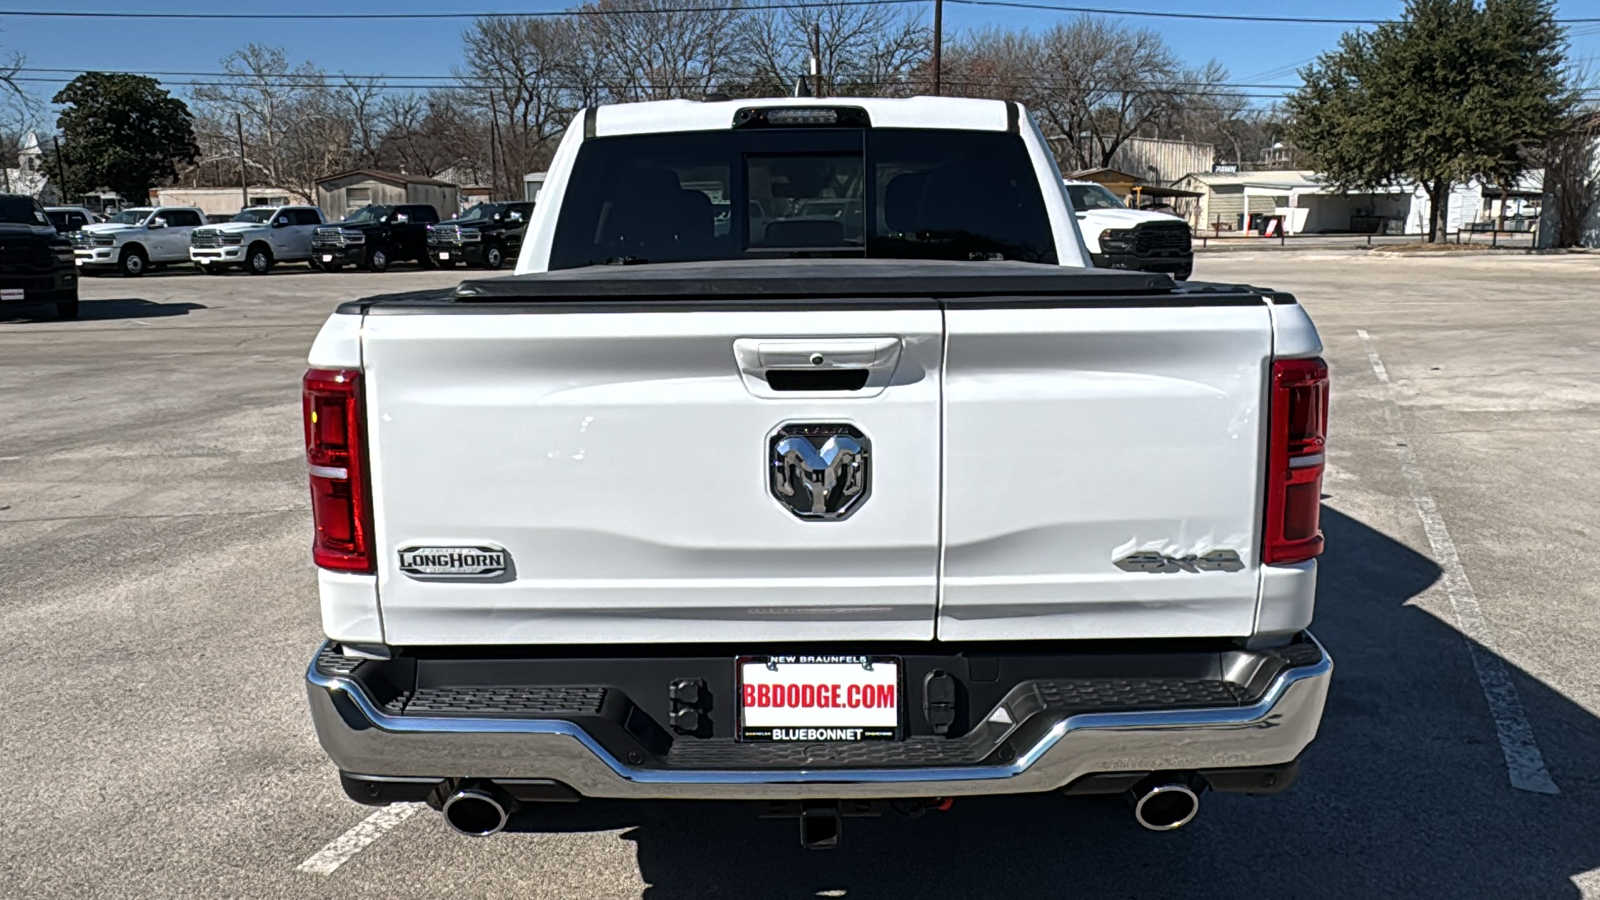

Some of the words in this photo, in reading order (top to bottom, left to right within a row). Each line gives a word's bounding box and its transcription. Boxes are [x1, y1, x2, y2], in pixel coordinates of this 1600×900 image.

[1215, 165, 1237, 173] PAWN
[743, 684, 895, 708] BBDODGE.COM
[772, 729, 863, 740] BLUEBONNET
